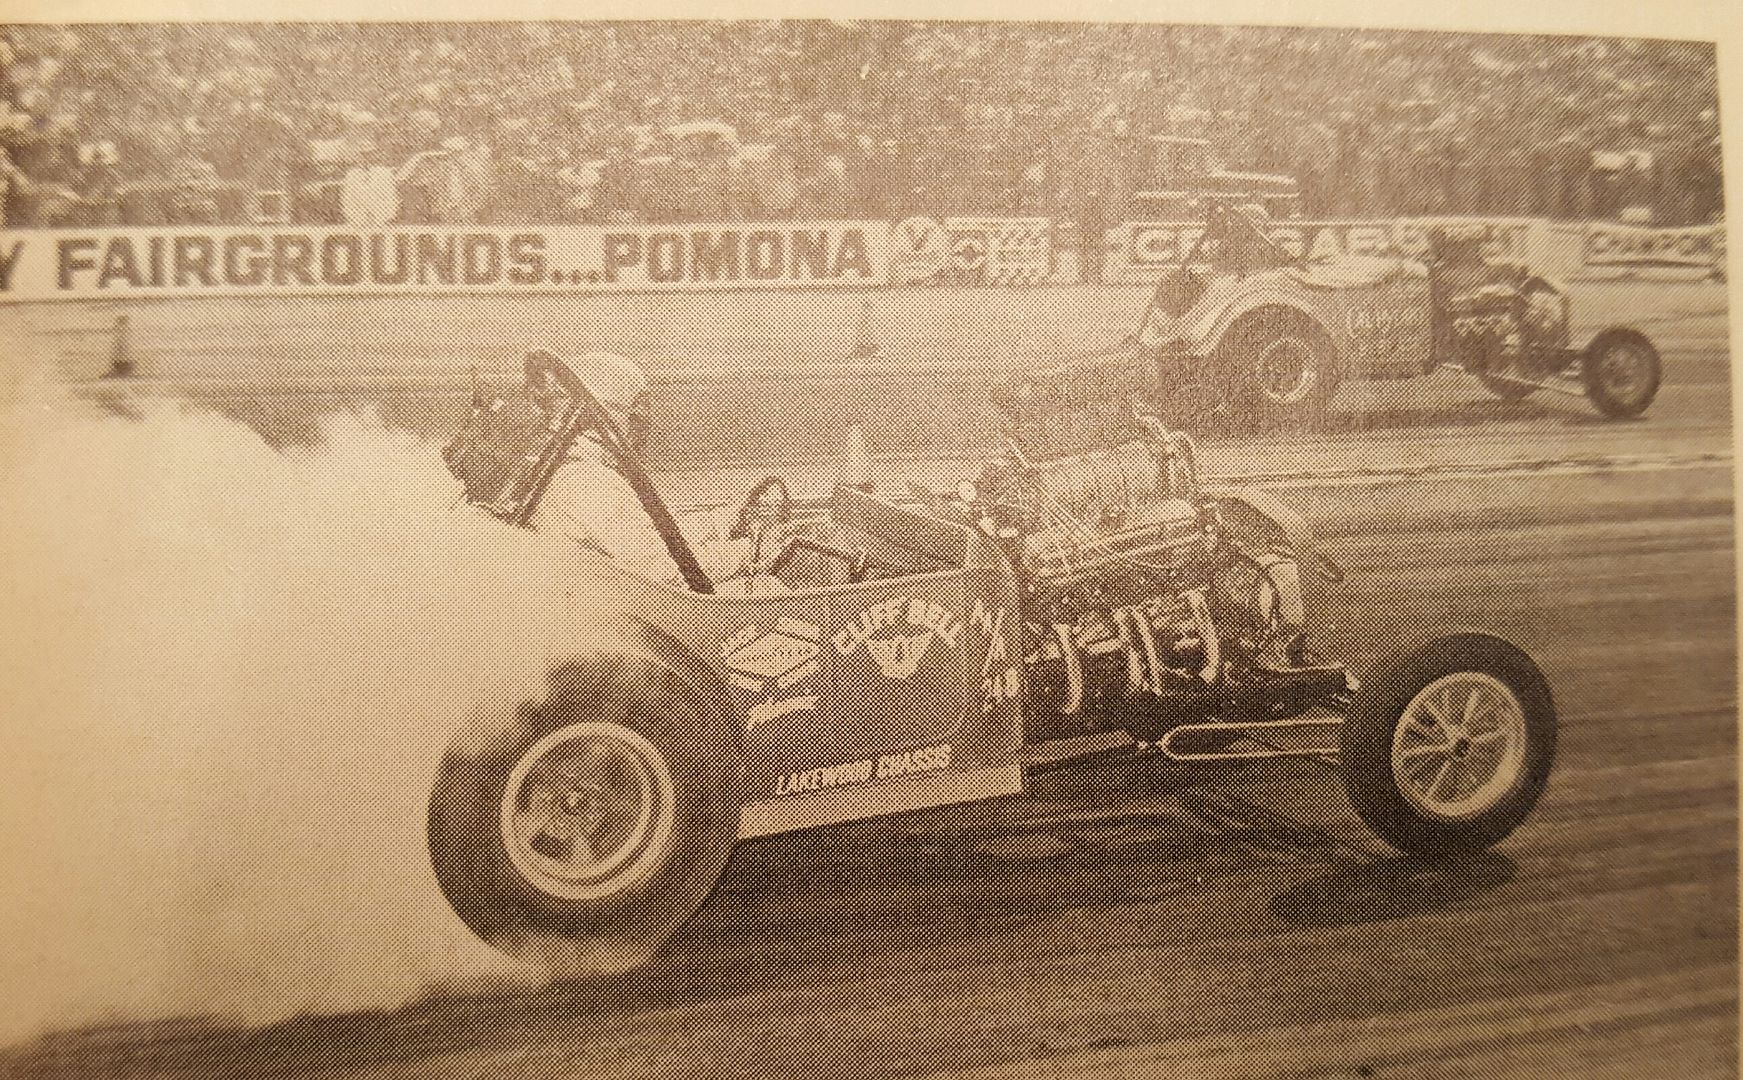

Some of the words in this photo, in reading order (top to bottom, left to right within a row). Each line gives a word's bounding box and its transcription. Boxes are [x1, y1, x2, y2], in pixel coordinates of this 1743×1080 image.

[830, 596, 907, 656] CLIFF
[906, 598, 962, 649] BELL
[775, 758, 873, 796] LAKEWOOD
[876, 743, 953, 778] CHASSIS
